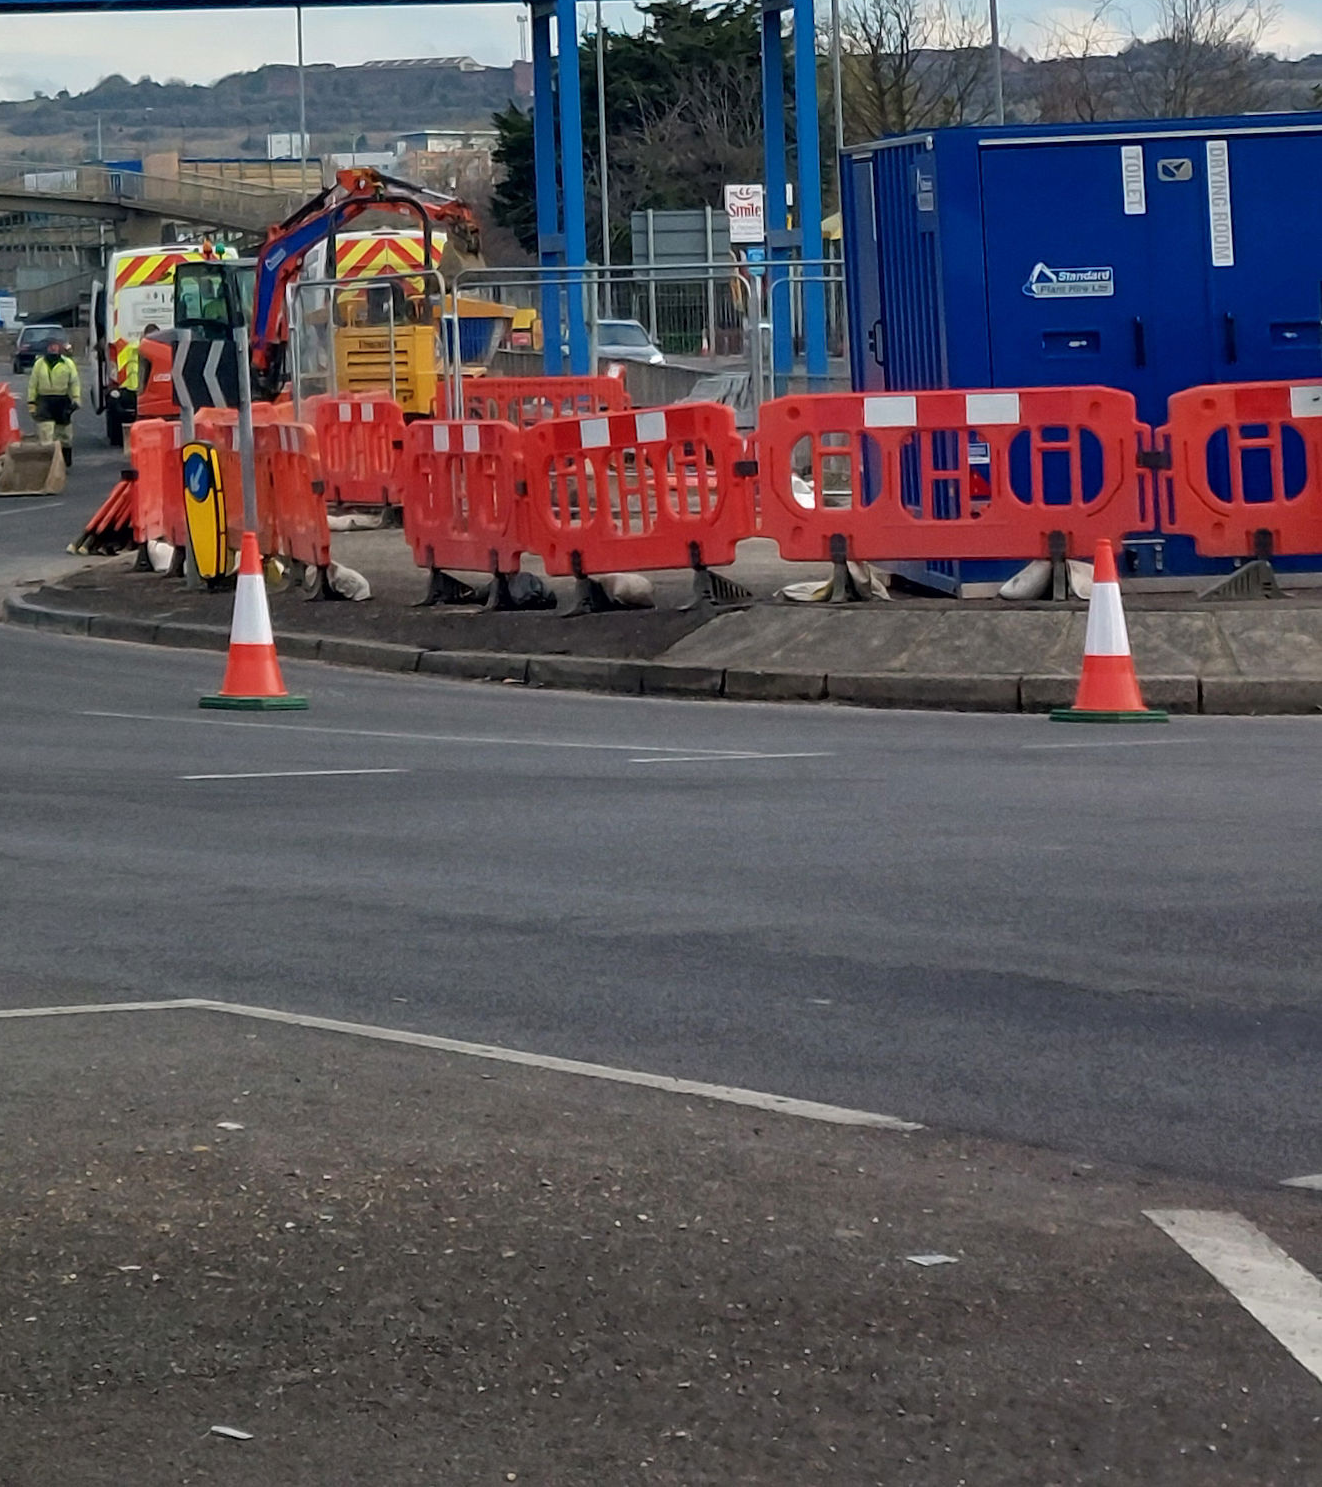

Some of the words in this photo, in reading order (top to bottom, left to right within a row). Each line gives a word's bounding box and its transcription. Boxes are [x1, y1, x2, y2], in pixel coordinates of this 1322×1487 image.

[1124, 150, 1143, 207] TOILET
[1209, 147, 1227, 207] DRYING
[729, 203, 762, 218] Smile
[1213, 214, 1232, 261] ROOM
[1058, 270, 1110, 282] Standard
